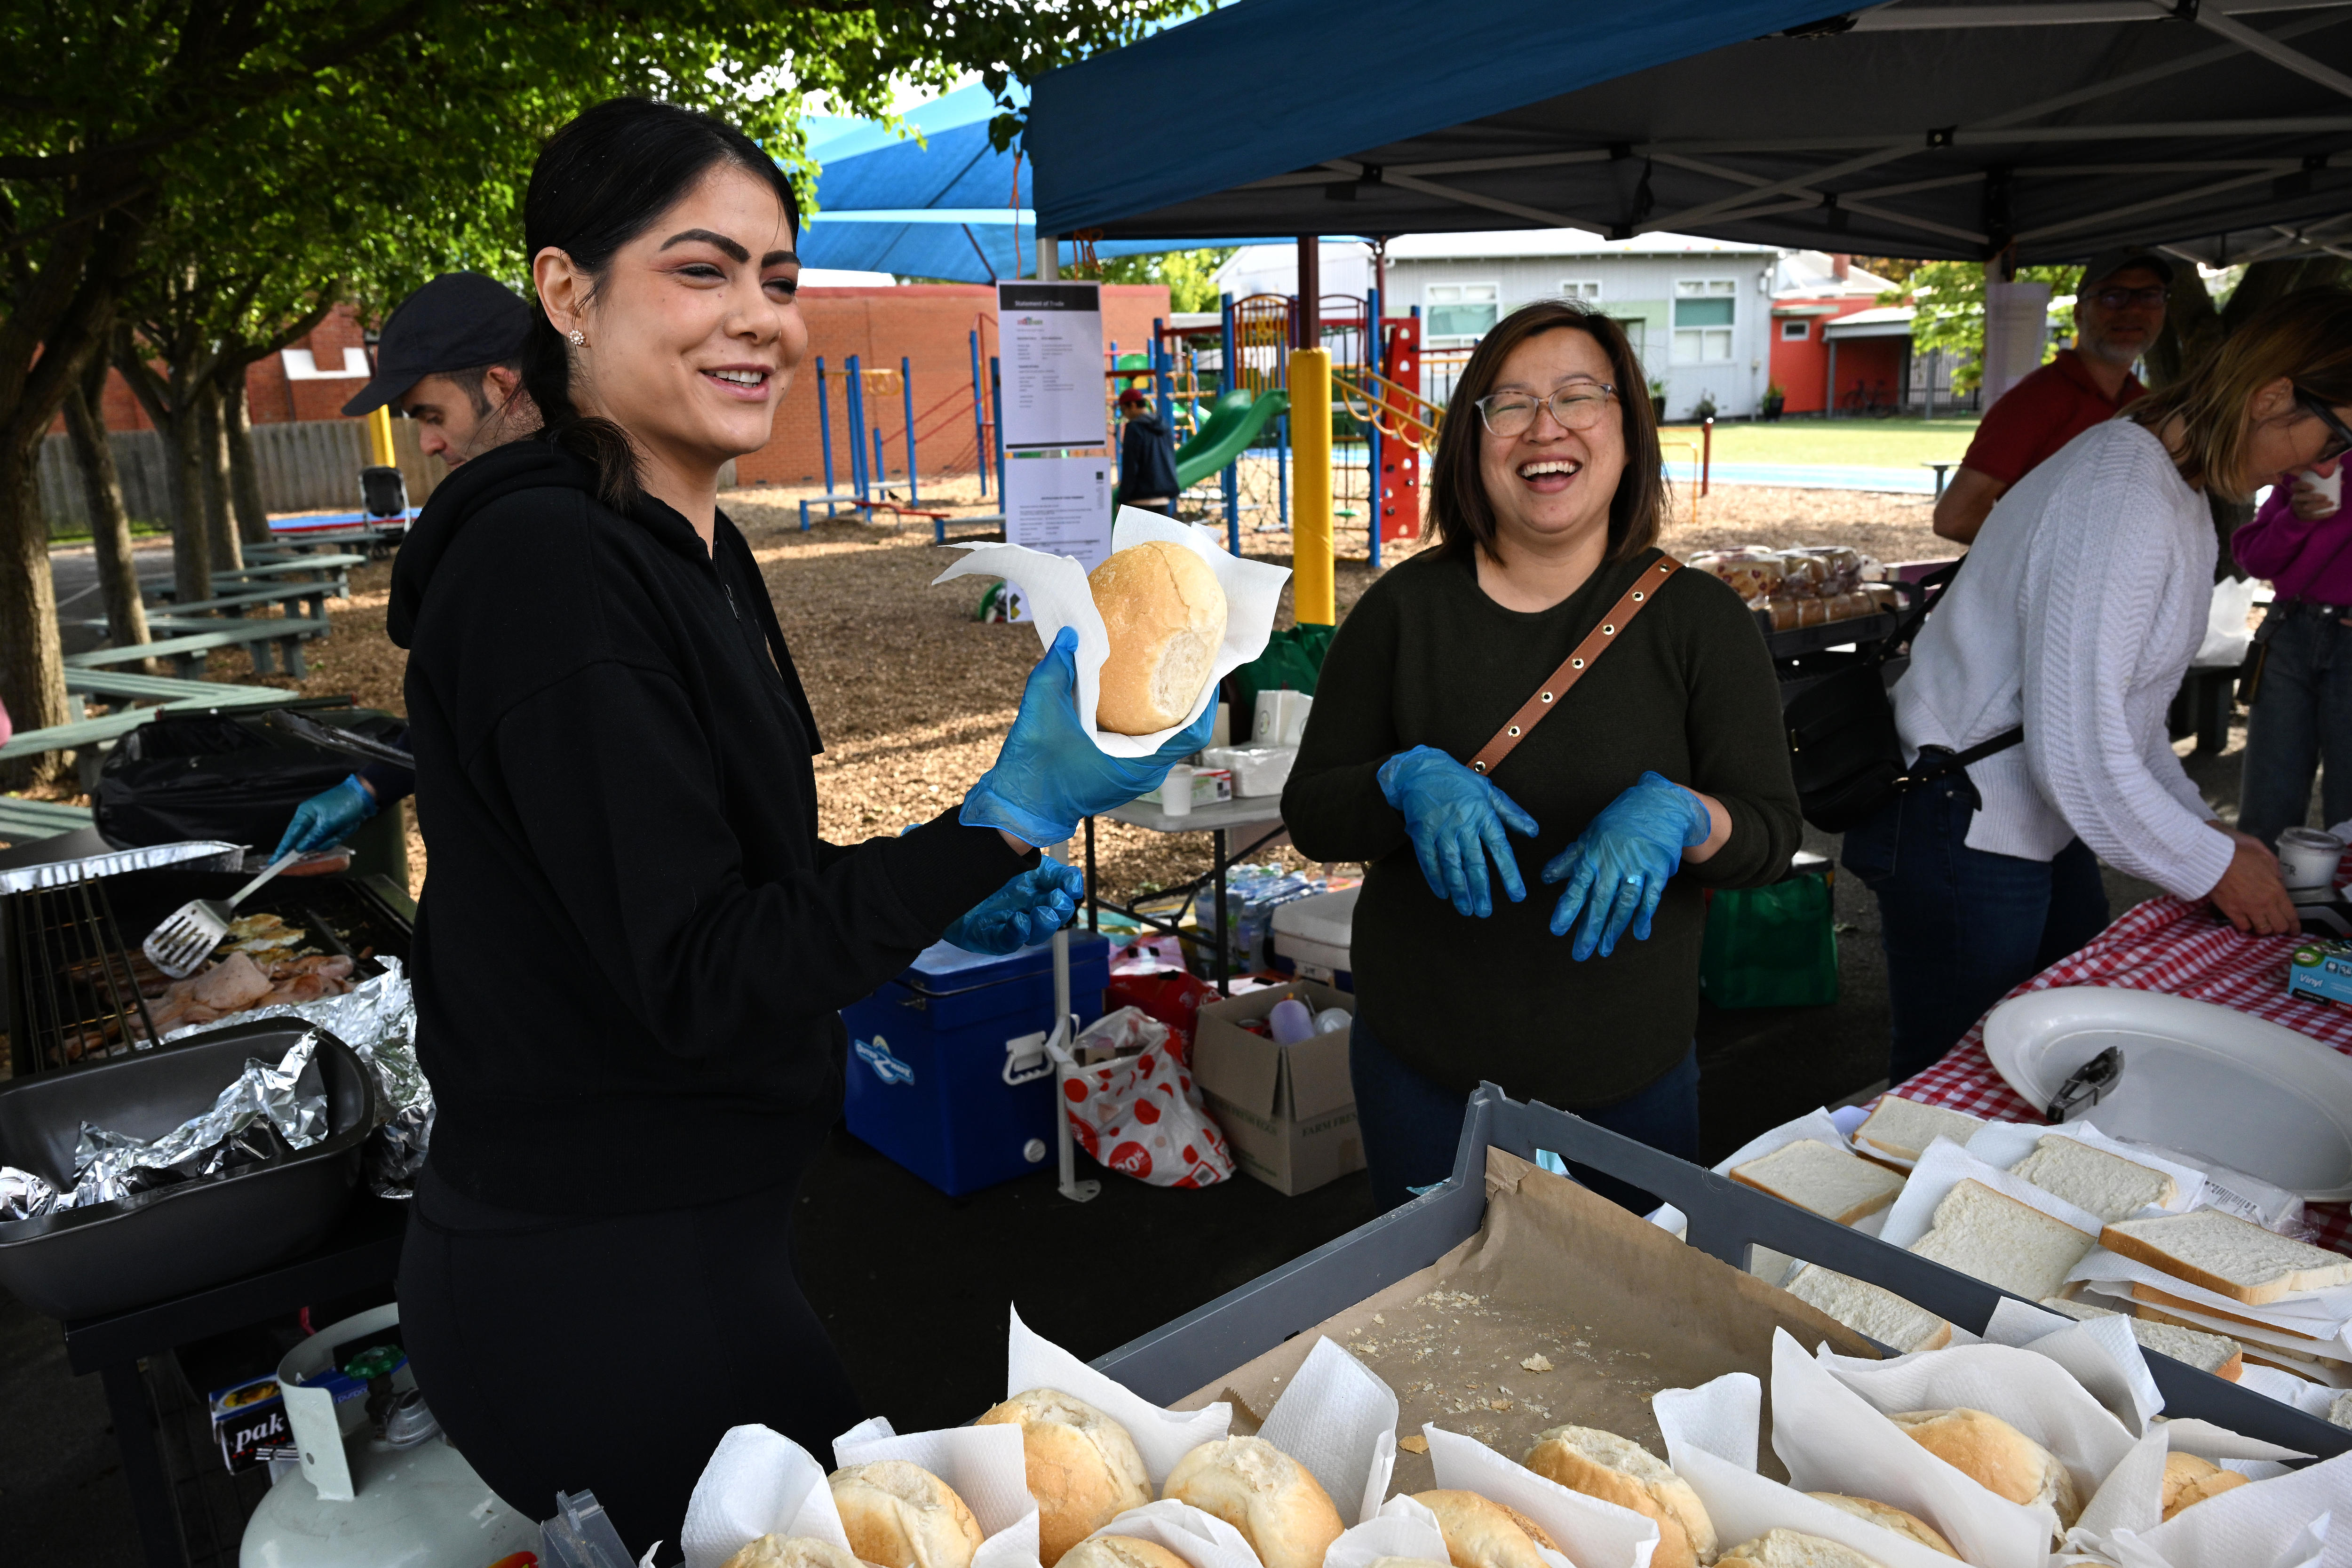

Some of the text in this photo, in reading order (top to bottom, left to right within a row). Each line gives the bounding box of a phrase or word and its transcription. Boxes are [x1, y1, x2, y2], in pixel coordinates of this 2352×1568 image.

[2300, 974, 2323, 987] Vinyl
[1302, 1111, 1357, 1137] FARM FRES
[234, 1413, 285, 1454] pak
